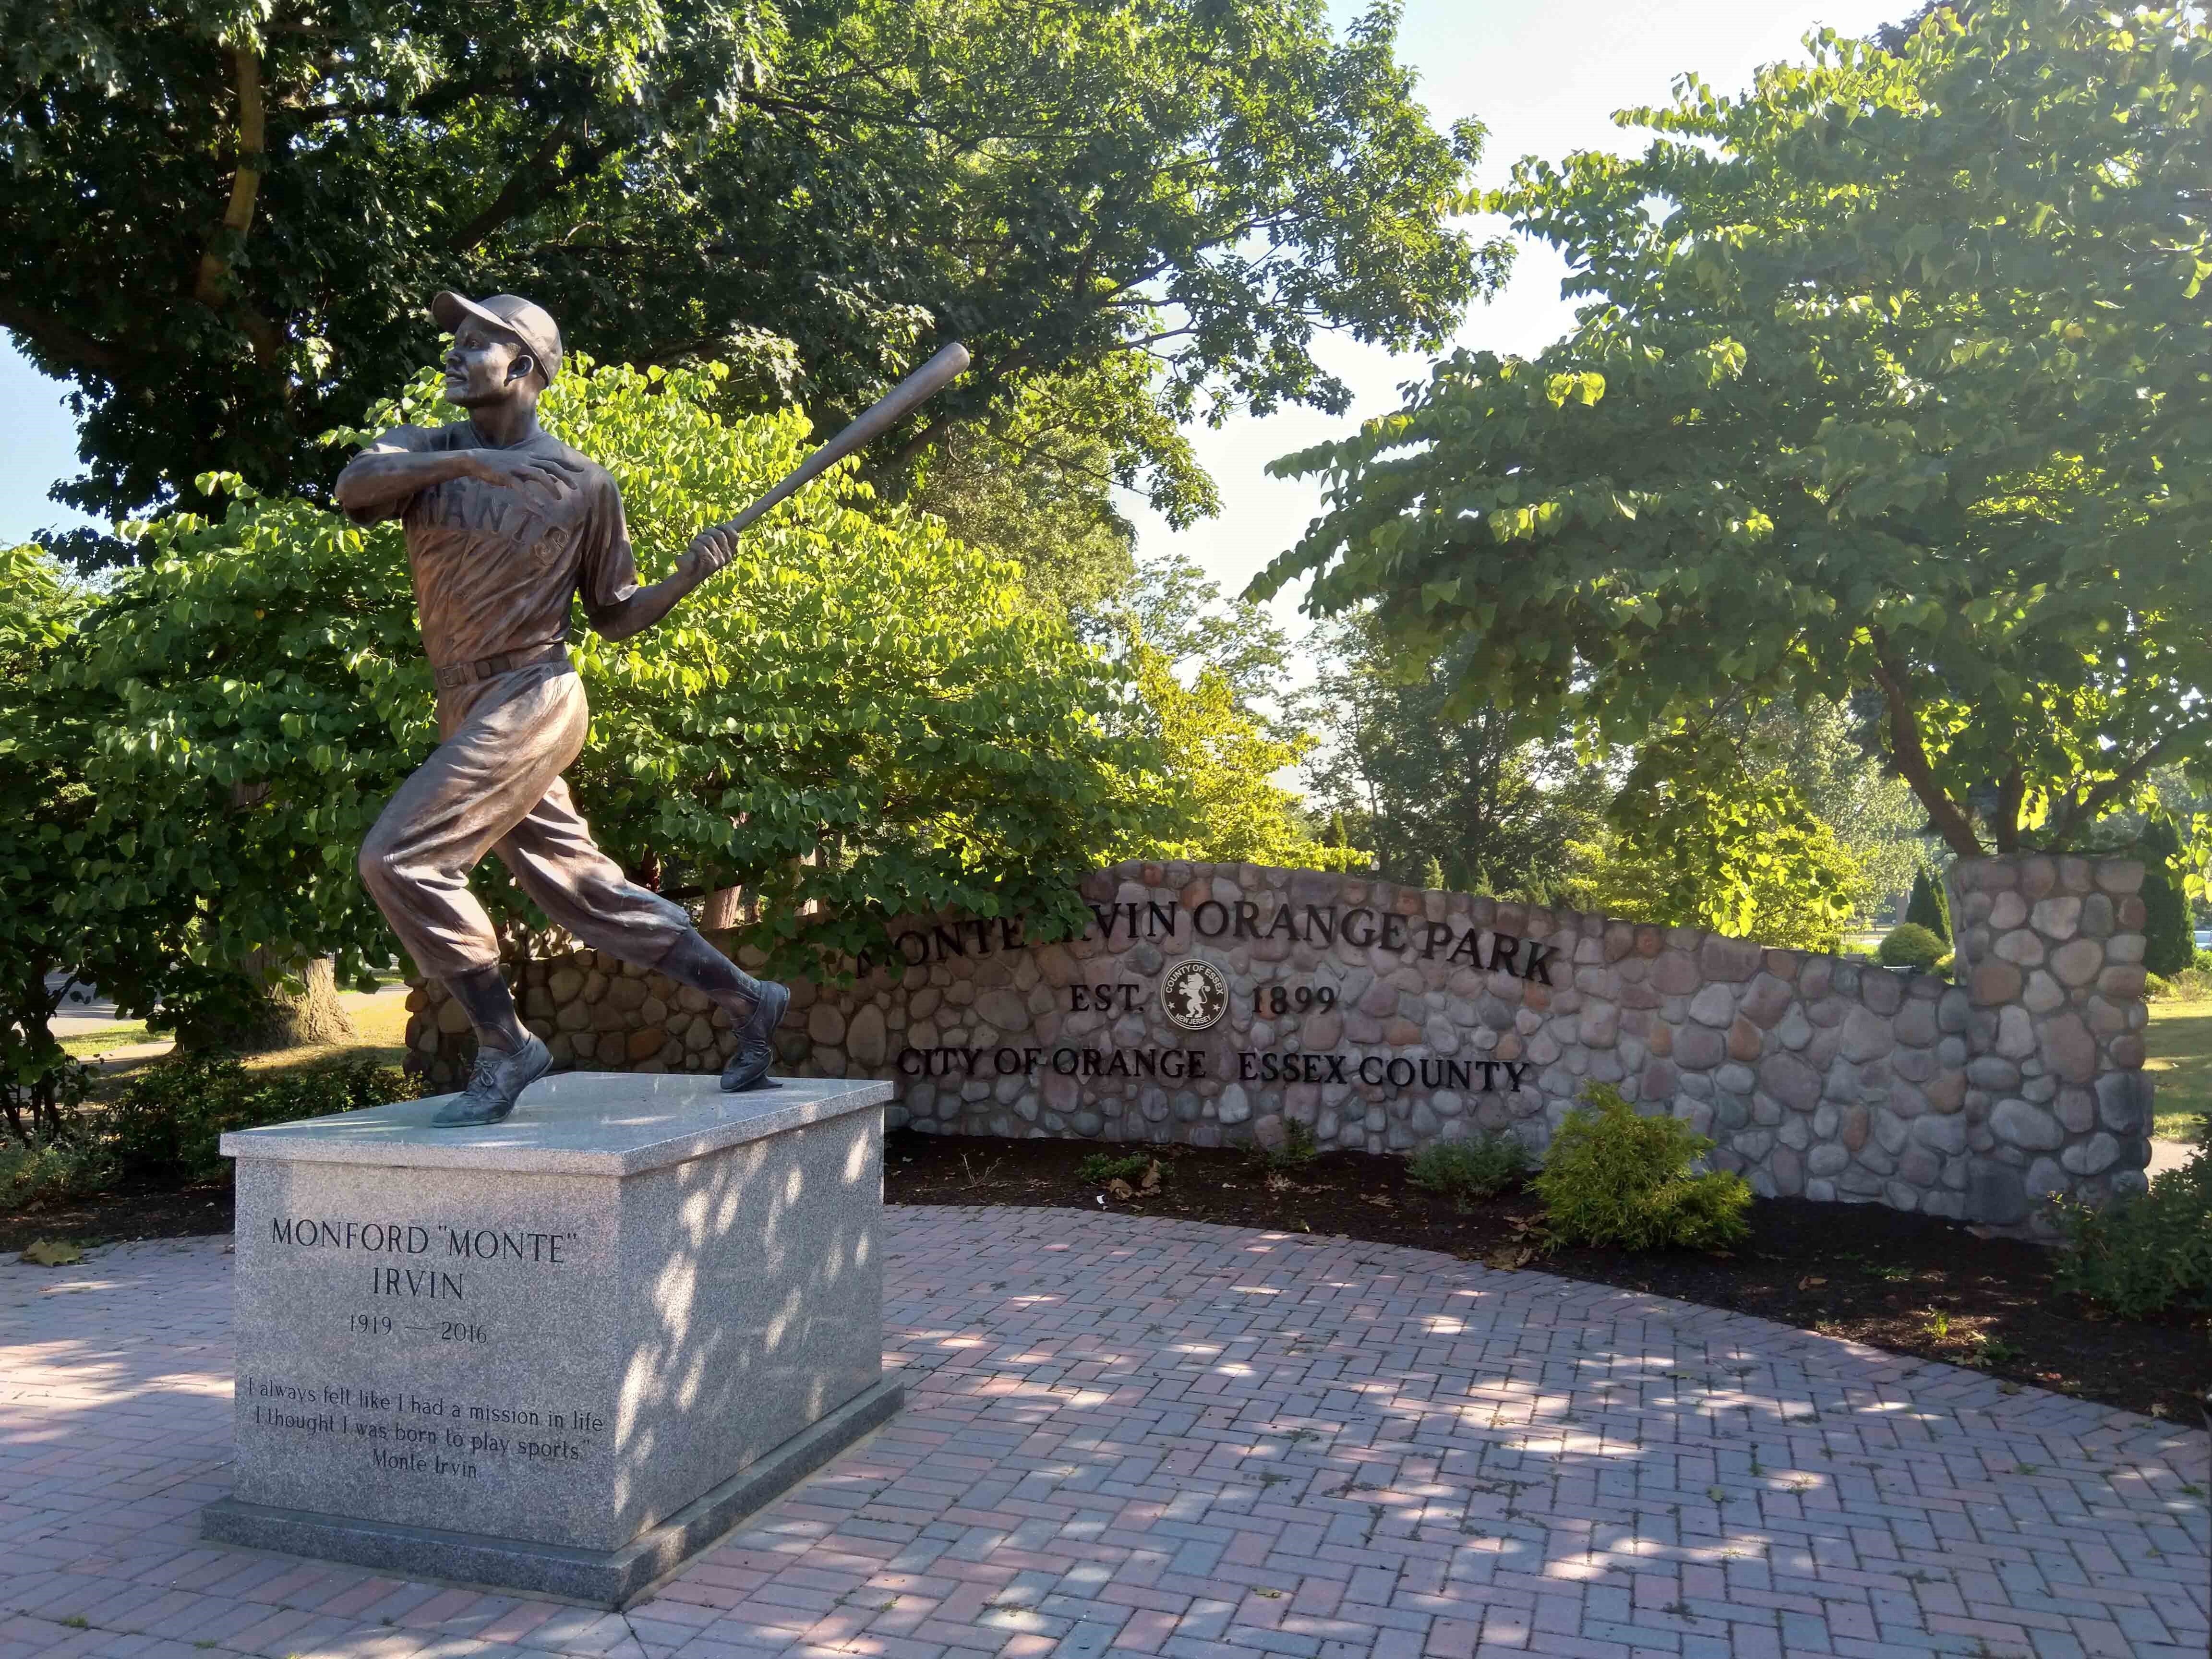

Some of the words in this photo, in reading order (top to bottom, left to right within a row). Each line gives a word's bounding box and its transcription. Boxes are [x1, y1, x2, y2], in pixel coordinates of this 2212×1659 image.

[1041, 901, 1178, 944] VIN
[1193, 900, 1408, 950] ORANGE
[1422, 922, 1560, 986] PARK
[1166, 964, 1191, 994] COUNTY
[1192, 964, 1205, 972] OF
[1204, 968, 1224, 995] ESSEX
[1070, 984, 1144, 1011] EST.
[1252, 986, 1335, 1015] 1899
[1175, 1013, 1190, 1023] NEW
[1189, 1014, 1212, 1025] JERSEY
[897, 1047, 984, 1077] CITY
[993, 1047, 1042, 1076] OF
[1053, 1048, 1206, 1079] ORANGE
[1238, 1052, 1348, 1084] ESSEX
[1359, 1056, 1530, 1093] COUNTY
[271, 1217, 429, 1253] MONFORD
[438, 1225, 577, 1263] "MONTE"
[373, 1267, 463, 1300] IRVIN
[350, 1314, 392, 1335] 1919
[441, 1321, 487, 1344] 2016
[260, 1380, 316, 1402] always
[323, 1386, 351, 1406] felt
[359, 1390, 391, 1410] like
[398, 1393, 403, 1411] I
[411, 1394, 443, 1416] had
[452, 1405, 460, 1417] a
[469, 1404, 539, 1425] mission
[548, 1410, 564, 1428] in
[572, 1410, 603, 1431] life
[255, 1406, 260, 1424] I
[268, 1407, 335, 1435] thought
[342, 1416, 348, 1434] I
[355, 1422, 387, 1439] was
[396, 1422, 436, 1444] born
[446, 1428, 463, 1447] to
[471, 1431, 510, 1455] play
[373, 1448, 427, 1472] Monte
[435, 1455, 477, 1478] Irvin
